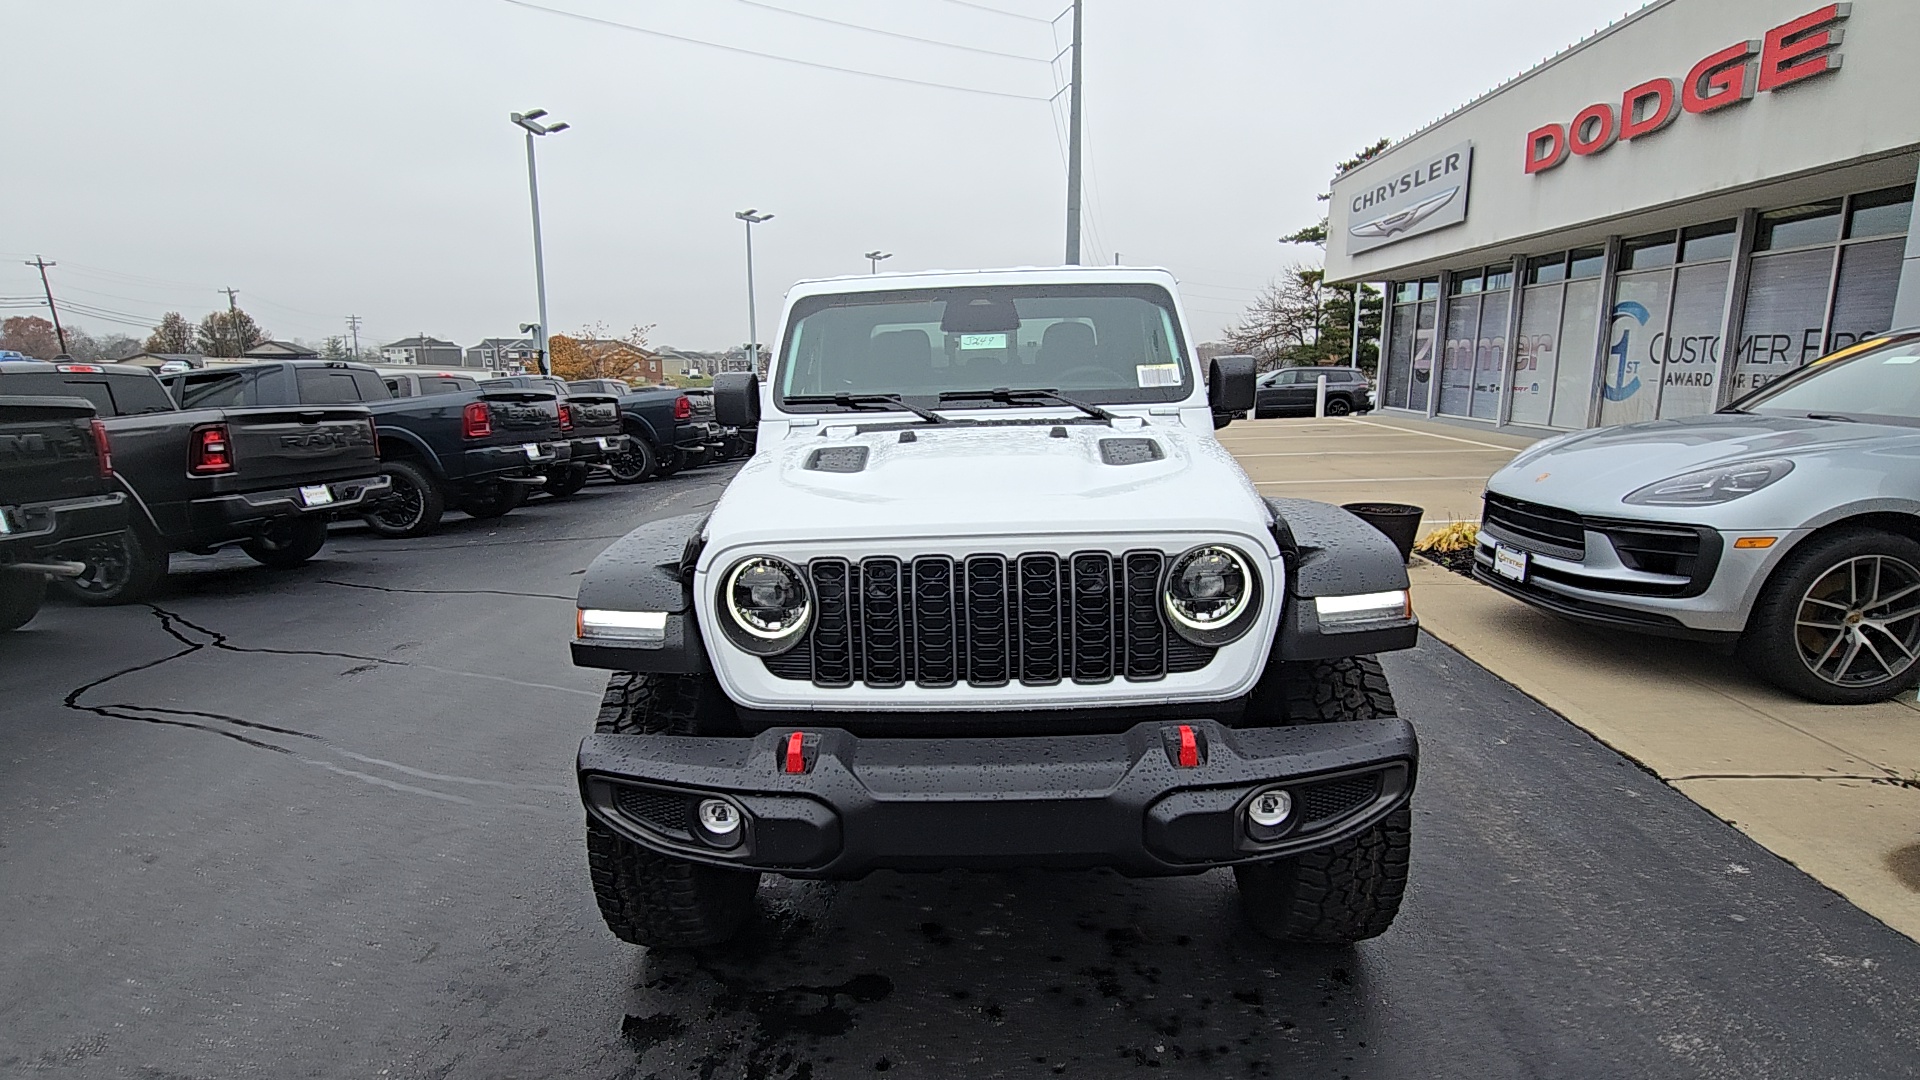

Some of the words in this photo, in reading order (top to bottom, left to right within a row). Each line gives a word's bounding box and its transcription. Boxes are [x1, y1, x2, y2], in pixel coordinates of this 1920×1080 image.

[1524, 3, 1846, 174] DODGE
[1352, 152, 1460, 213] CHRYSLER
[1414, 328, 1552, 371] Zmmer
[1665, 372, 1713, 387] AWARD
